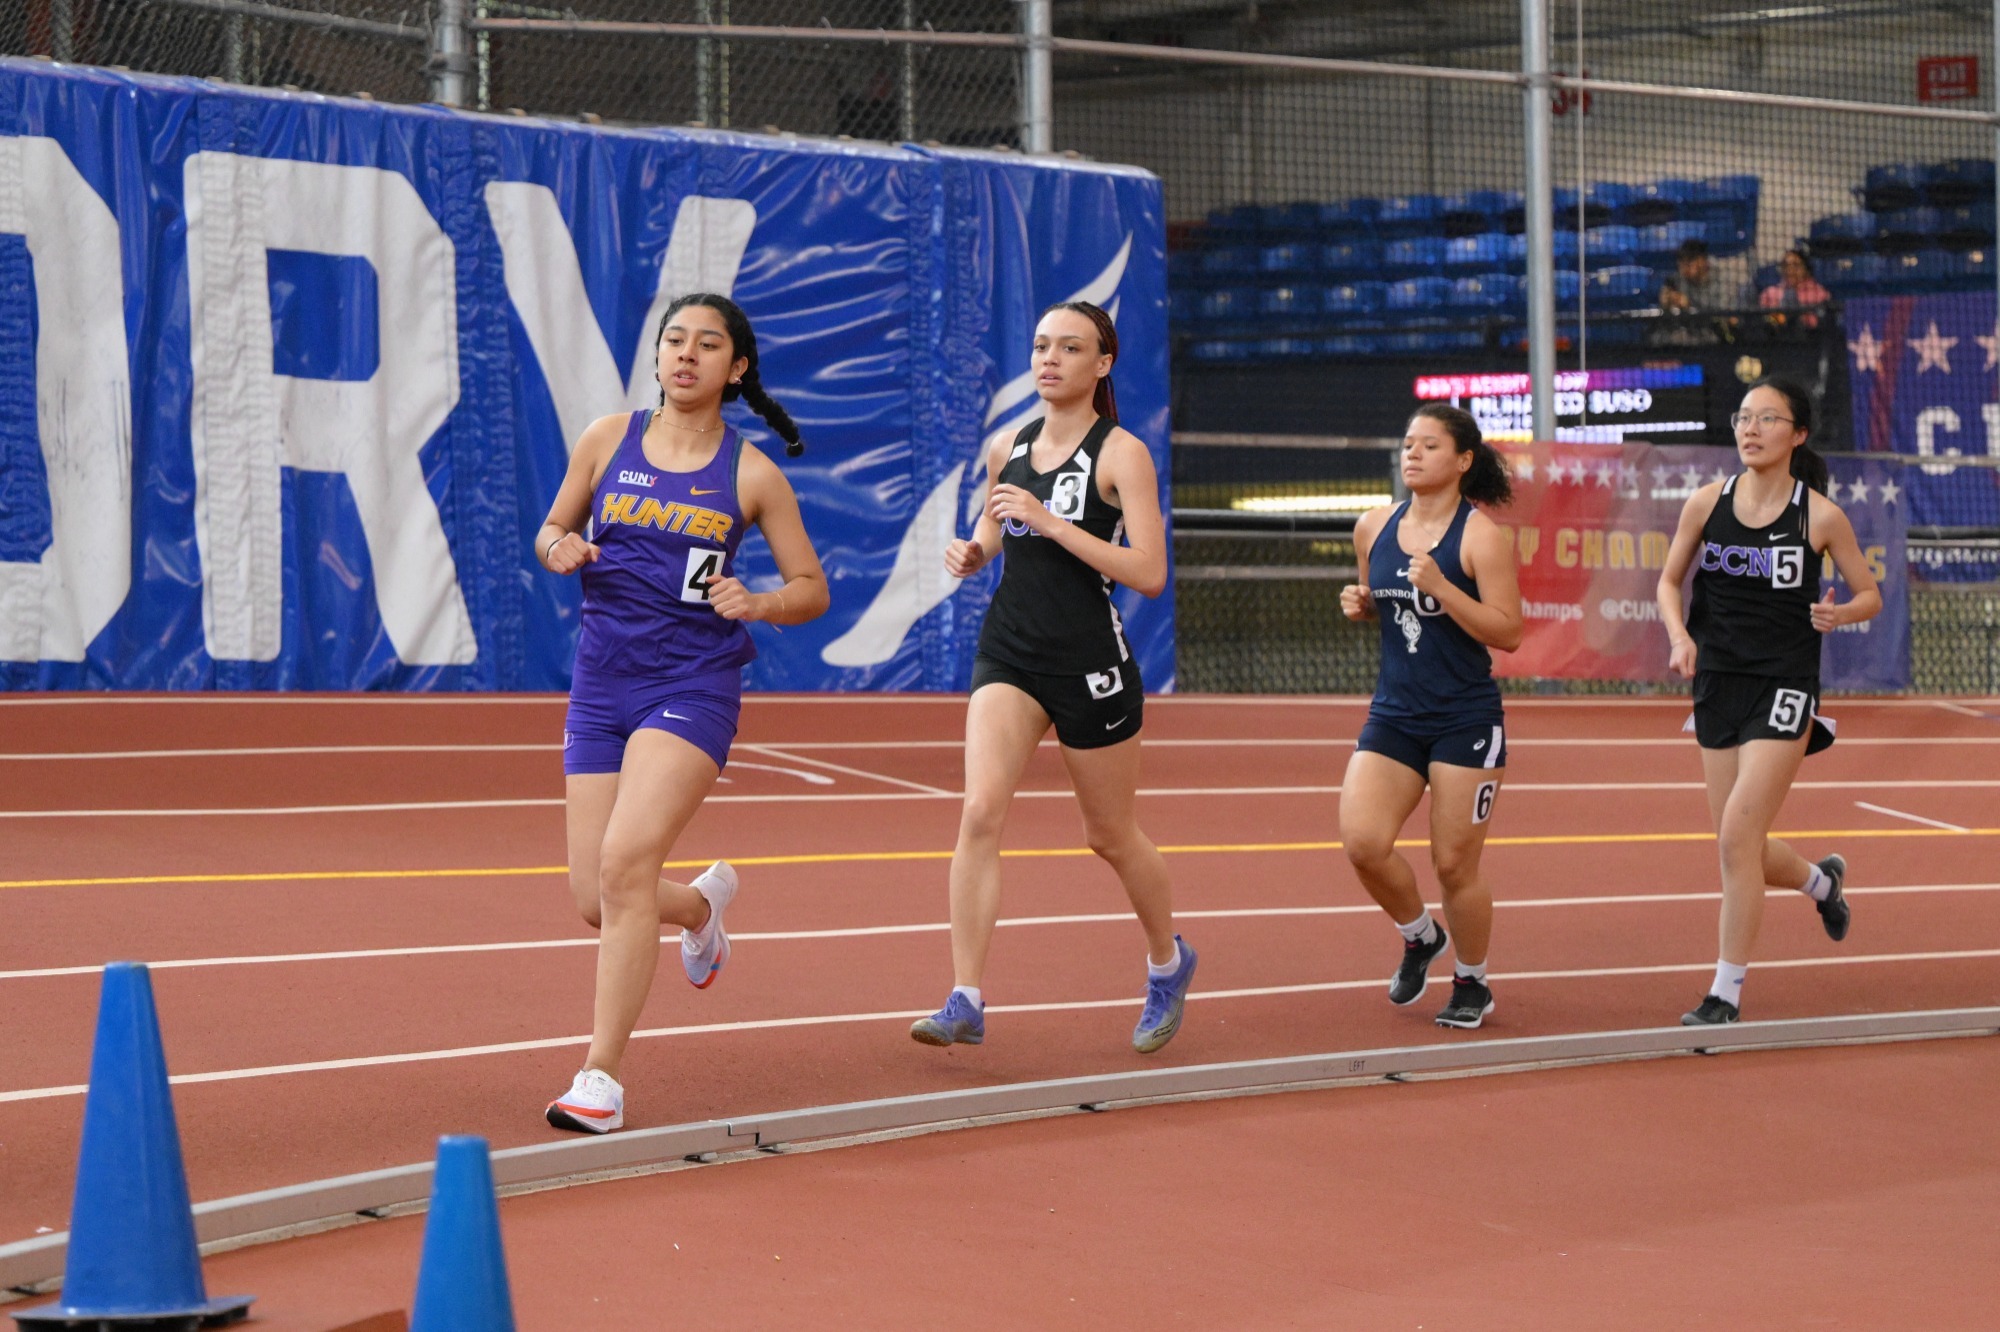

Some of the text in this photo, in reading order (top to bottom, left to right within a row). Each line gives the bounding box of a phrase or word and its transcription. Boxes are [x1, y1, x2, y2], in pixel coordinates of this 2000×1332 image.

[619, 469, 658, 486] CUNY
[1055, 475, 1081, 516] 3
[600, 492, 734, 544] HUNTER
[688, 553, 719, 601] 4
[1701, 541, 1773, 577] CCN
[1776, 550, 1799, 585] 5
[1774, 691, 1801, 727] 5
[1477, 784, 1494, 820] 6
[1348, 1059, 1366, 1072] LEFT
